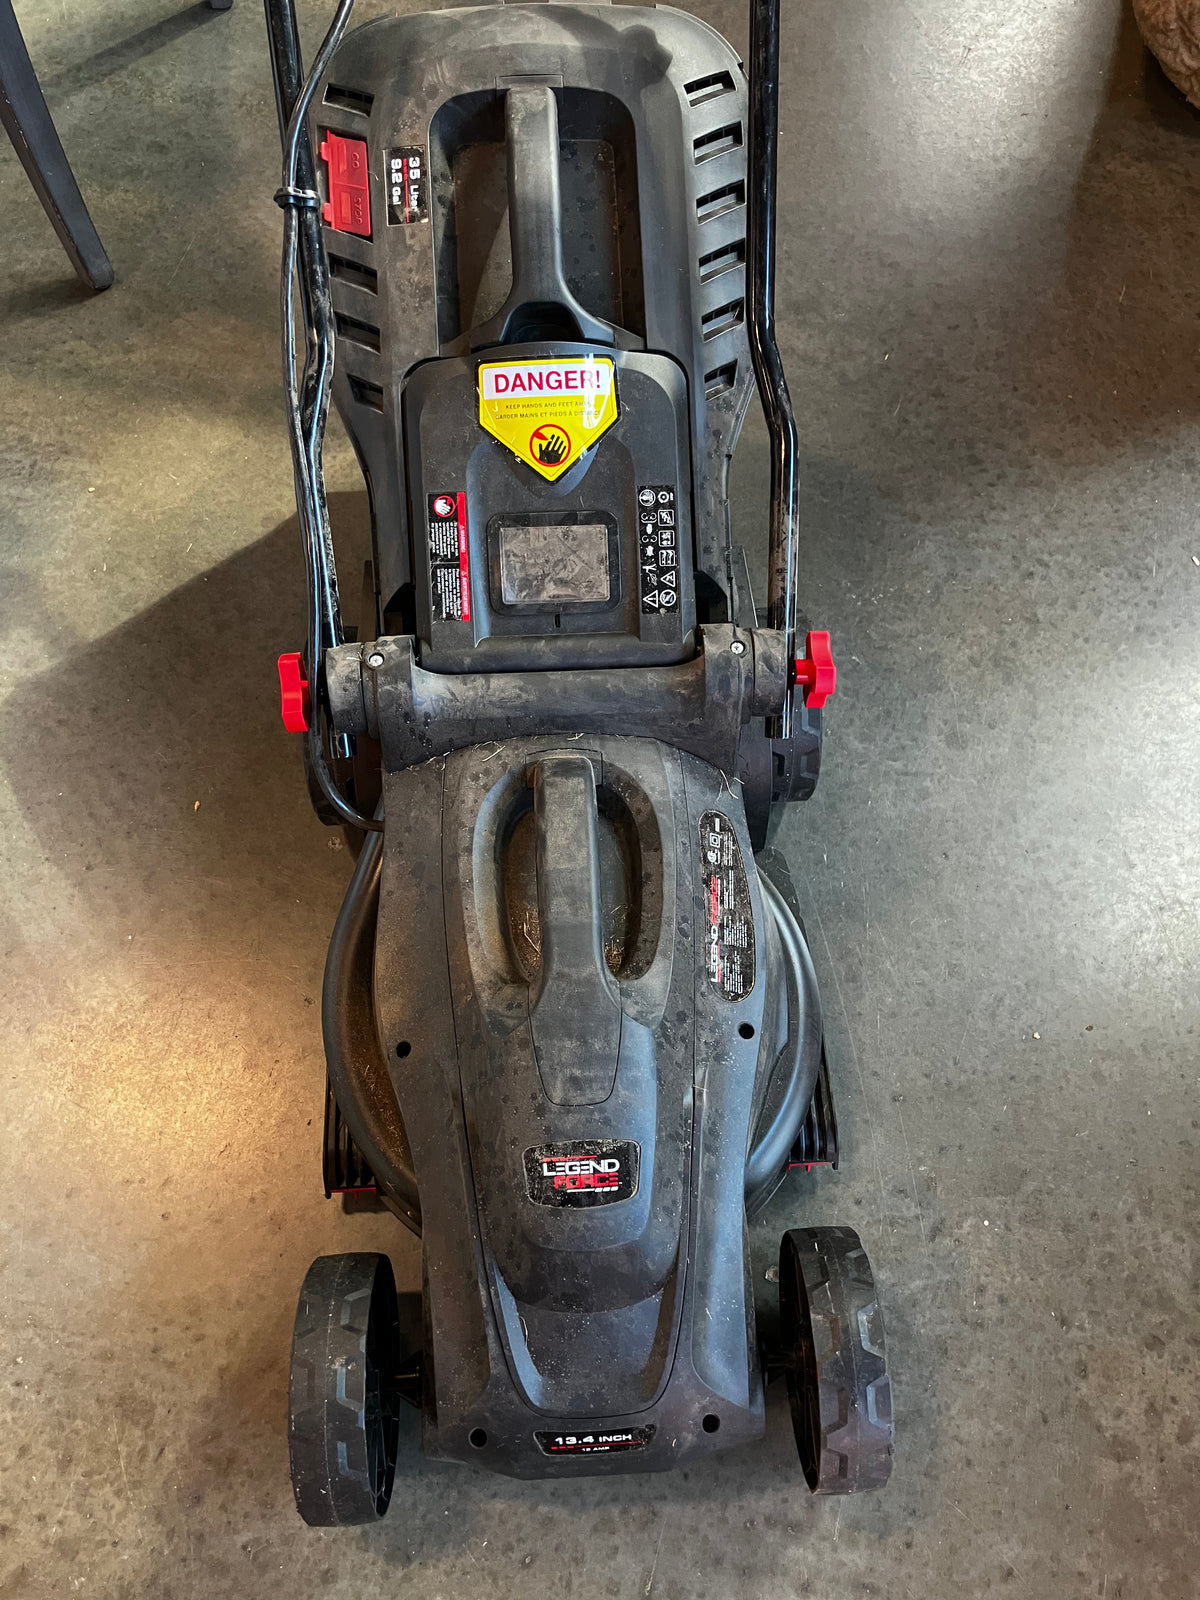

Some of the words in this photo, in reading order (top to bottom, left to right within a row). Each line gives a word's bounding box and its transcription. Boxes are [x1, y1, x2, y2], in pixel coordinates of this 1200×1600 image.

[352, 152, 360, 169] GO
[391, 159, 403, 184] 9.2
[409, 157, 420, 180] 35
[392, 186, 401, 205] Gal
[410, 185, 419, 212] Liter
[354, 196, 362, 225] STOP
[494, 370, 600, 393] DANGER!
[710, 877, 718, 924] FORCE
[710, 925, 719, 983] LEGEND
[542, 1158, 620, 1176] LEGEND
[554, 1172, 619, 1190] FORCE
[555, 1436, 594, 1445] 13.4
[599, 1434, 632, 1442] INCH
